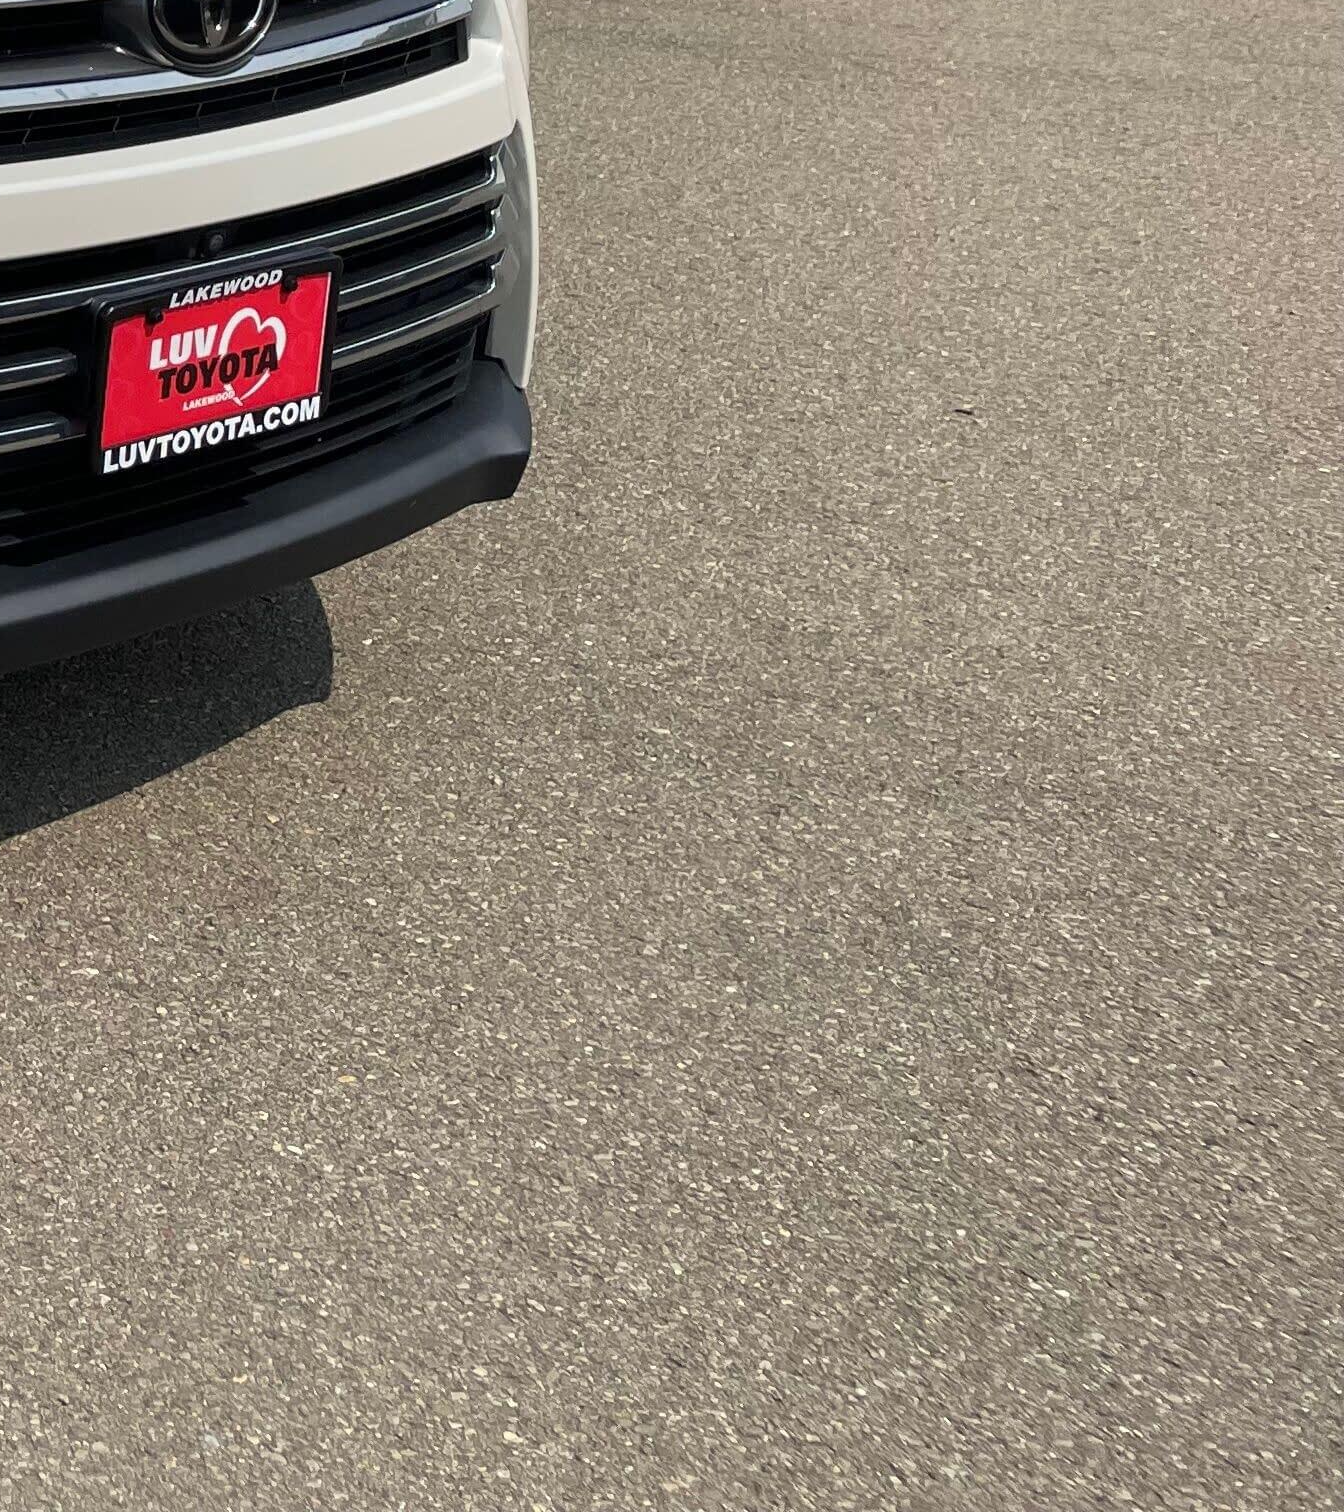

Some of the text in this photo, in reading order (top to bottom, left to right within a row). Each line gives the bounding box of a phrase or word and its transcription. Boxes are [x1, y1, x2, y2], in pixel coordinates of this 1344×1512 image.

[169, 269, 283, 310] LAKEWOOD
[149, 324, 218, 371] LUV
[158, 343, 278, 400] TOYOTA
[182, 390, 235, 412] LAKEWOOD
[103, 396, 321, 474] LUVTOYOTA.COM
